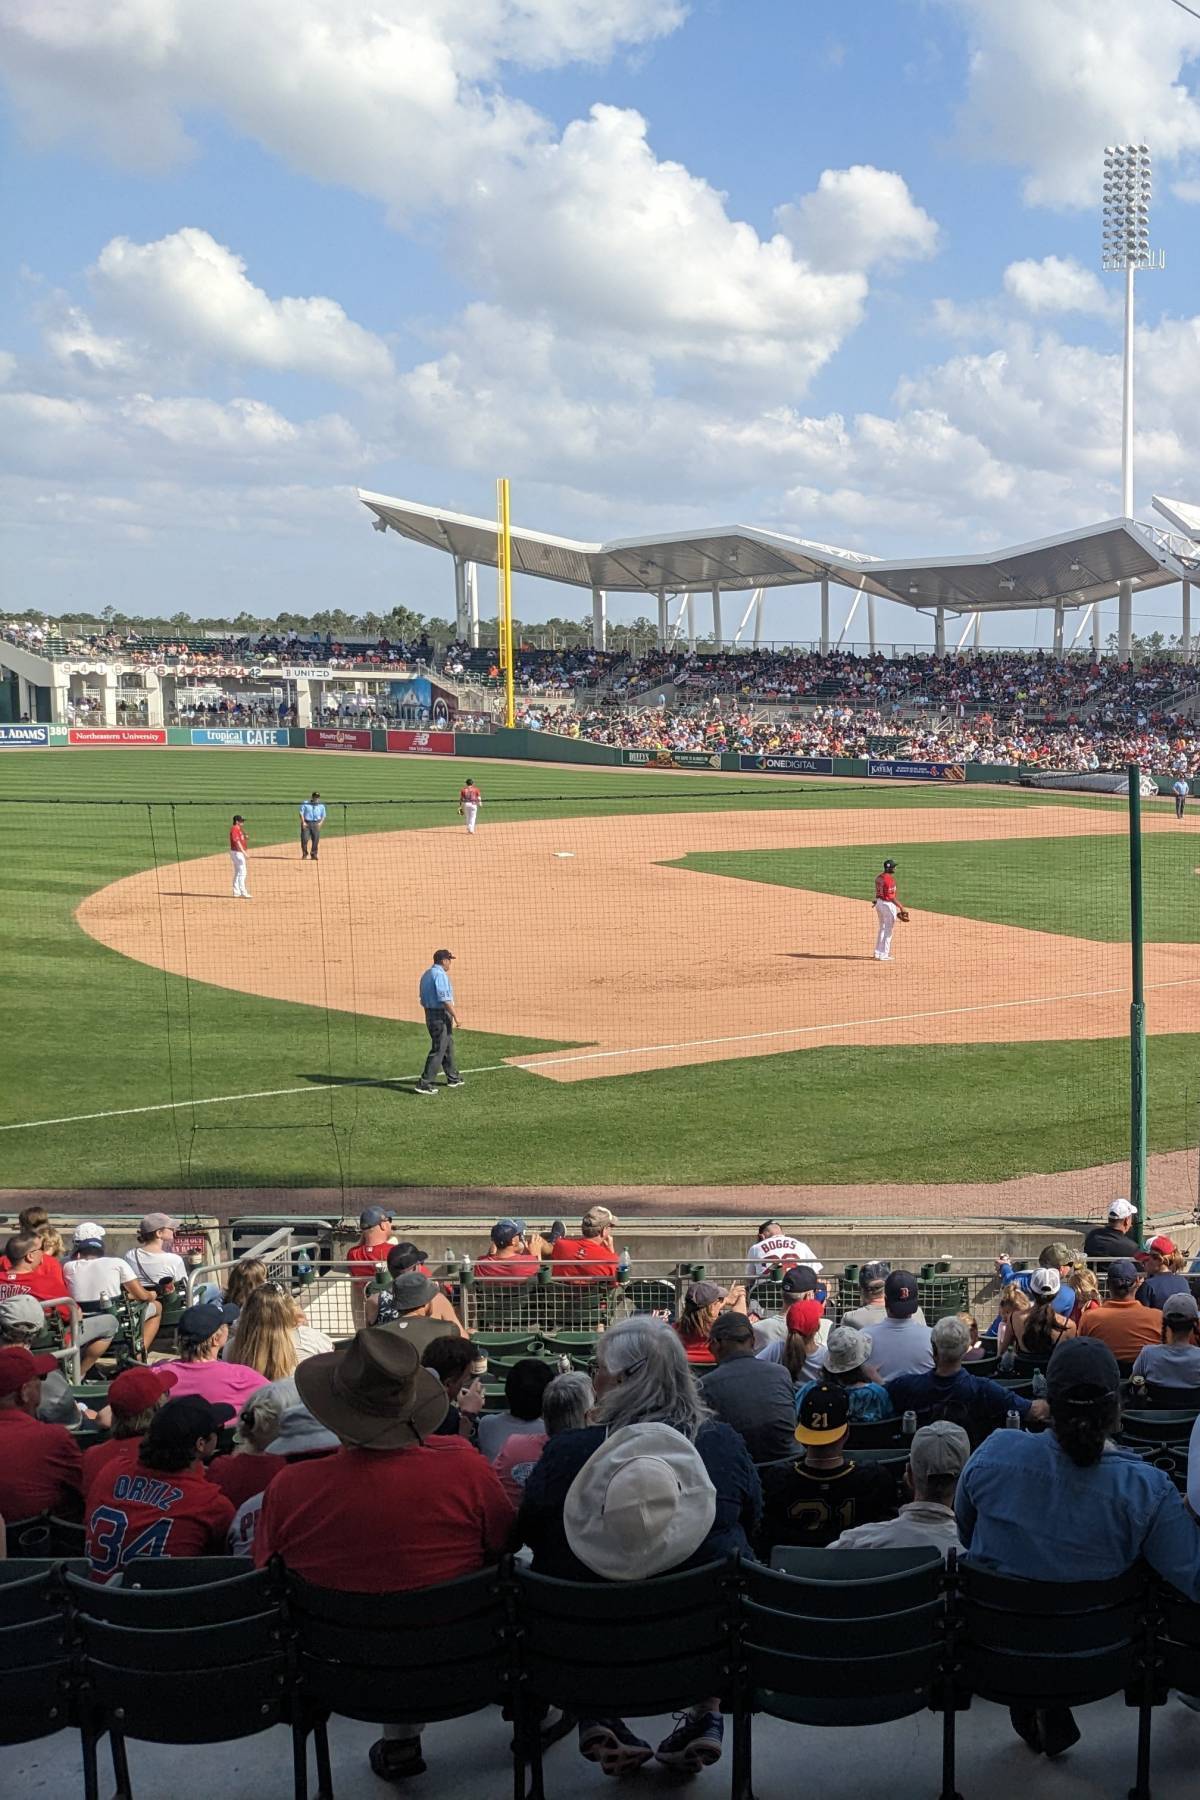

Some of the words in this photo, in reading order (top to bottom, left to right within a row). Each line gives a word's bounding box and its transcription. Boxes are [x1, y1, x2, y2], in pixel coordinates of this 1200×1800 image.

[250, 668, 261, 677] 42
[9, 728, 46, 740] ADAMS
[50, 726, 68, 736] 380
[76, 732, 121, 741] Northeastern
[122, 733, 160, 742] University
[207, 730, 243, 744] tropical
[247, 730, 278, 745] CAFE
[766, 759, 817, 770] ONEDIGITAL
[761, 1239, 798, 1254] BOGGS
[0, 1284, 32, 1302] RTIZ
[811, 1412, 828, 1428] 21
[113, 1474, 184, 1511] ORTIZ
[86, 1504, 175, 1575] 34
